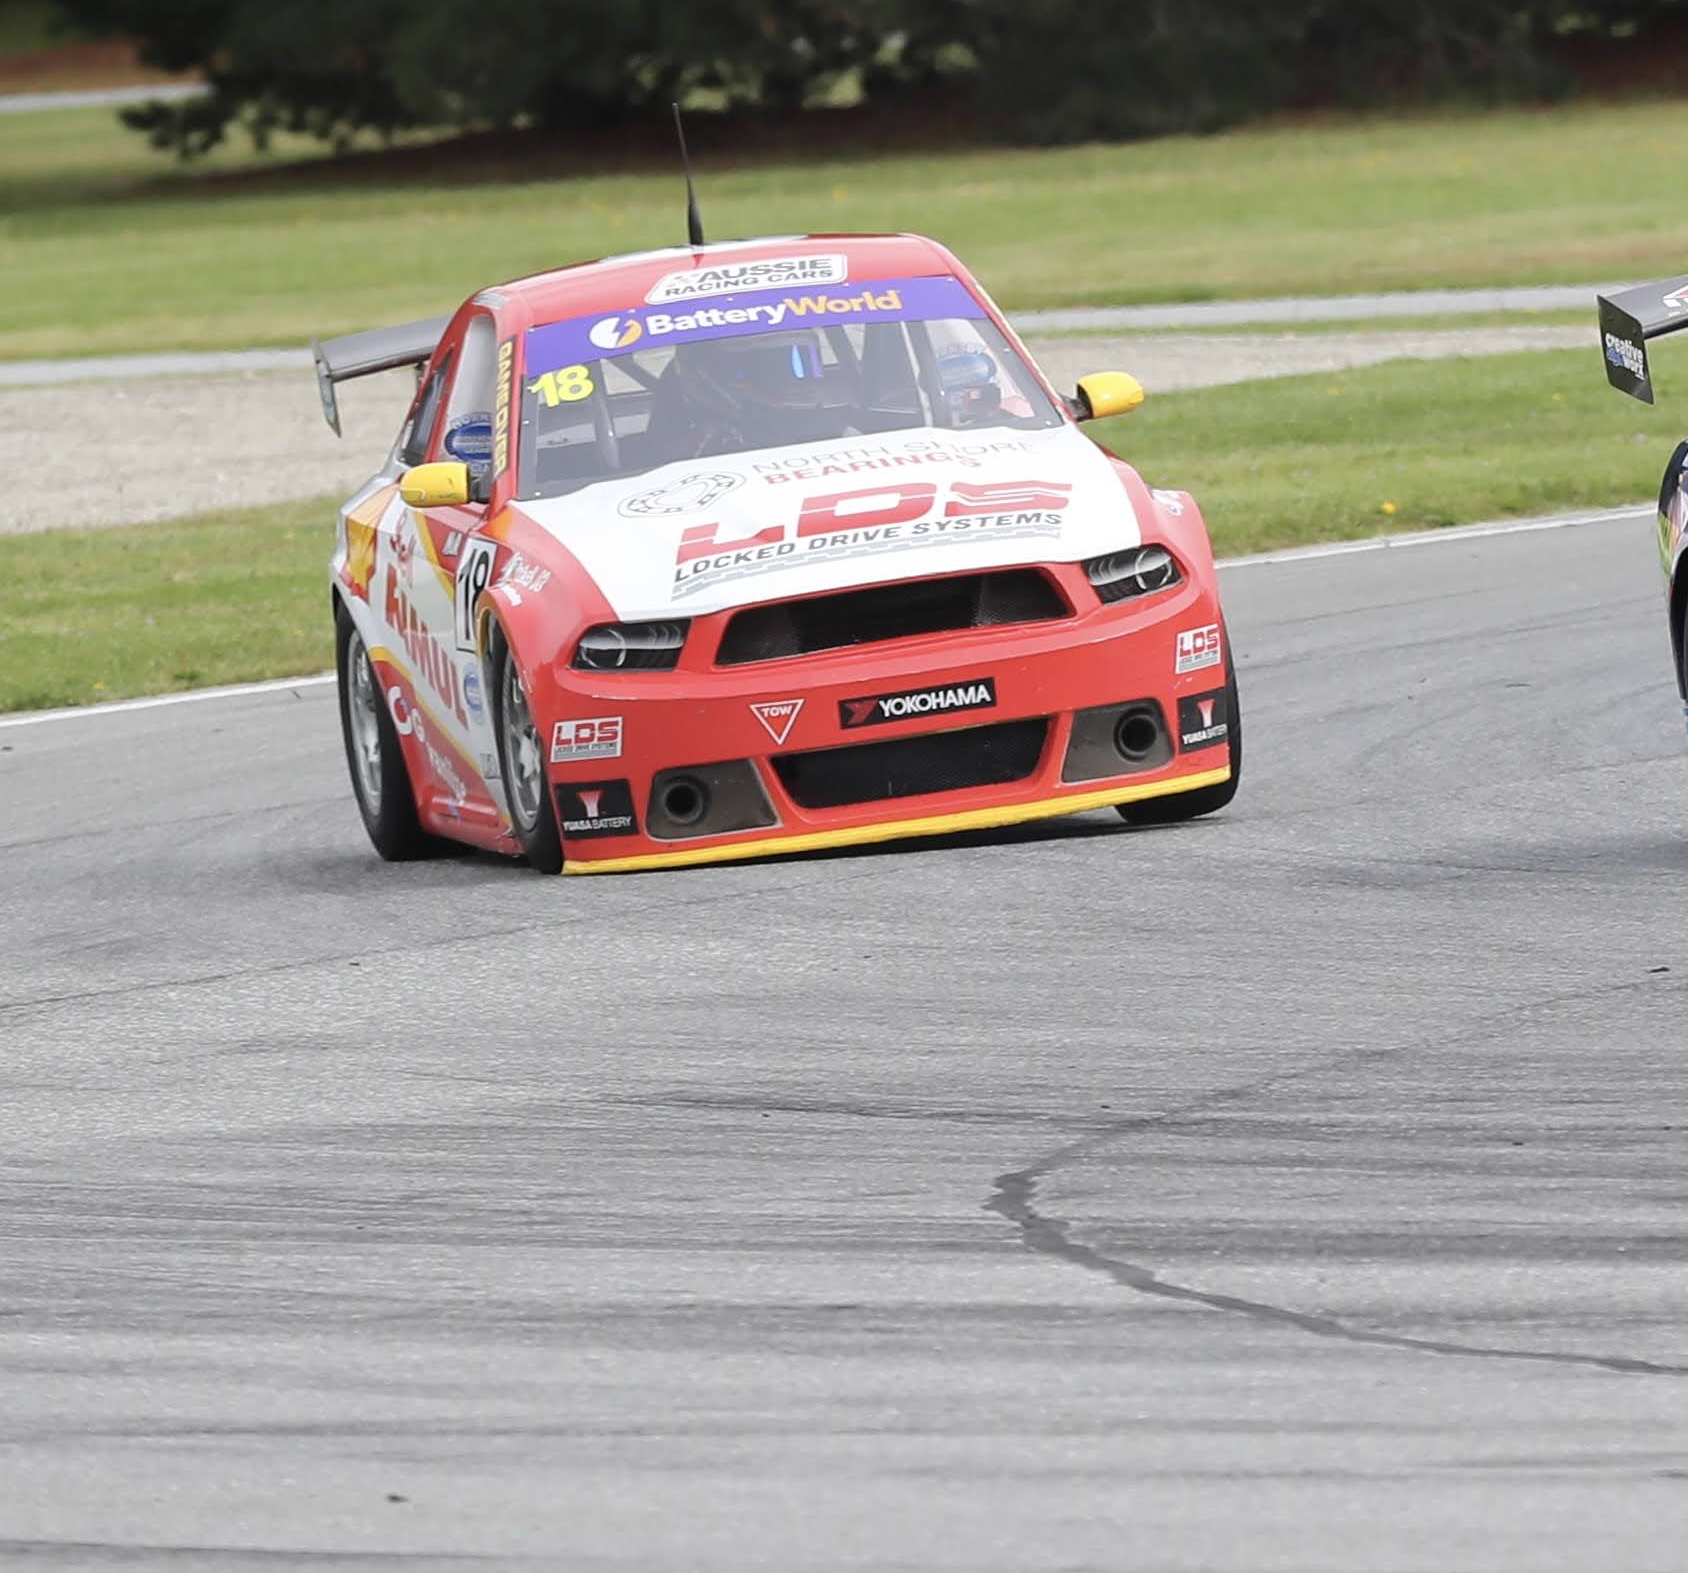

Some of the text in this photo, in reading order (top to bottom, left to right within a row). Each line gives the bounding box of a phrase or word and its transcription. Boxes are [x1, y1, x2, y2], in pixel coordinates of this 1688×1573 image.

[665, 268, 833, 298] RACING CARS
[697, 257, 834, 283] AUSSIE
[528, 364, 595, 408] 18
[752, 446, 889, 474] NORTH
[675, 480, 1073, 567] LDS
[675, 512, 1063, 584] LOCKED DRIVE SYSTEMS
[1179, 628, 1218, 658] LDS
[761, 705, 793, 719] TOW
[878, 683, 992, 717] YOKOHAMA
[555, 720, 620, 746] LDS
[563, 816, 632, 831] YUASA BATTERY
